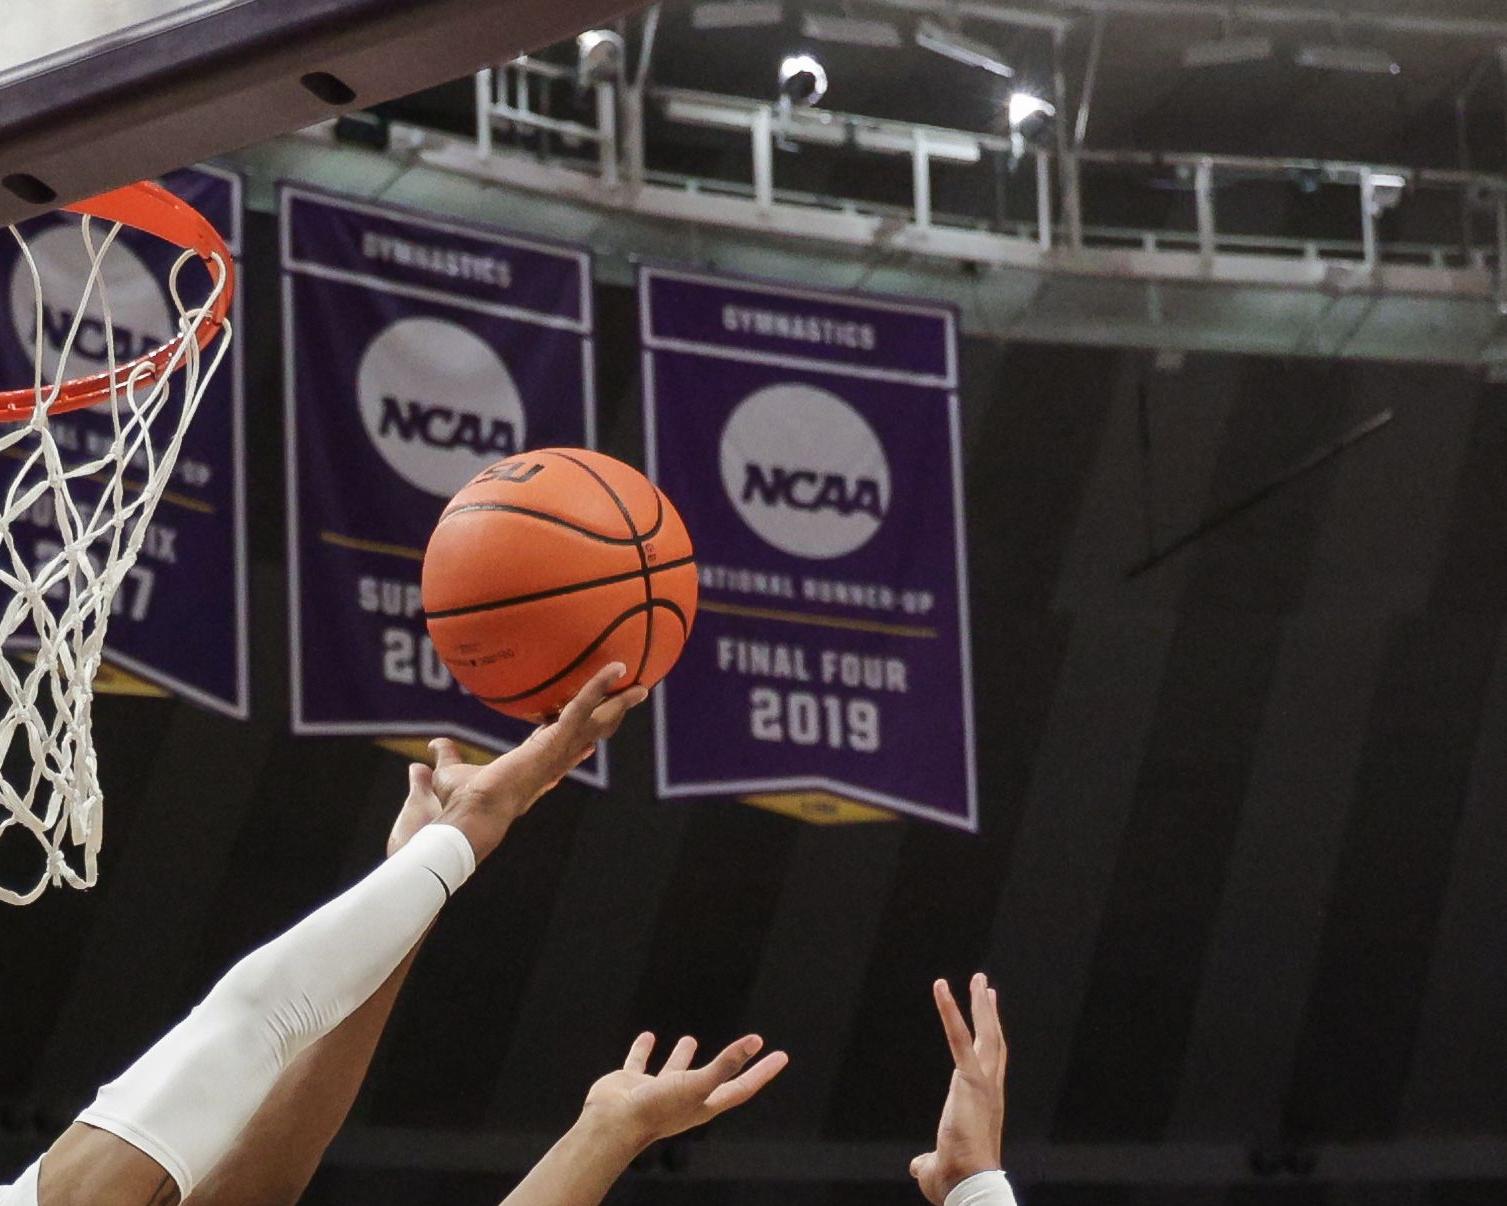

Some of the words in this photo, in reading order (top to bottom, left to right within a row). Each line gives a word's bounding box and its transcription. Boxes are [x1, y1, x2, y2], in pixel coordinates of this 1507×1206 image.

[721, 303, 876, 351] GYMNASTICS
[378, 396, 519, 457] NCAA
[742, 462, 886, 519] NCAA
[358, 576, 423, 618] SUP
[716, 635, 810, 682] FINAL
[820, 650, 908, 694] FOUR
[749, 686, 881, 754] 2019
